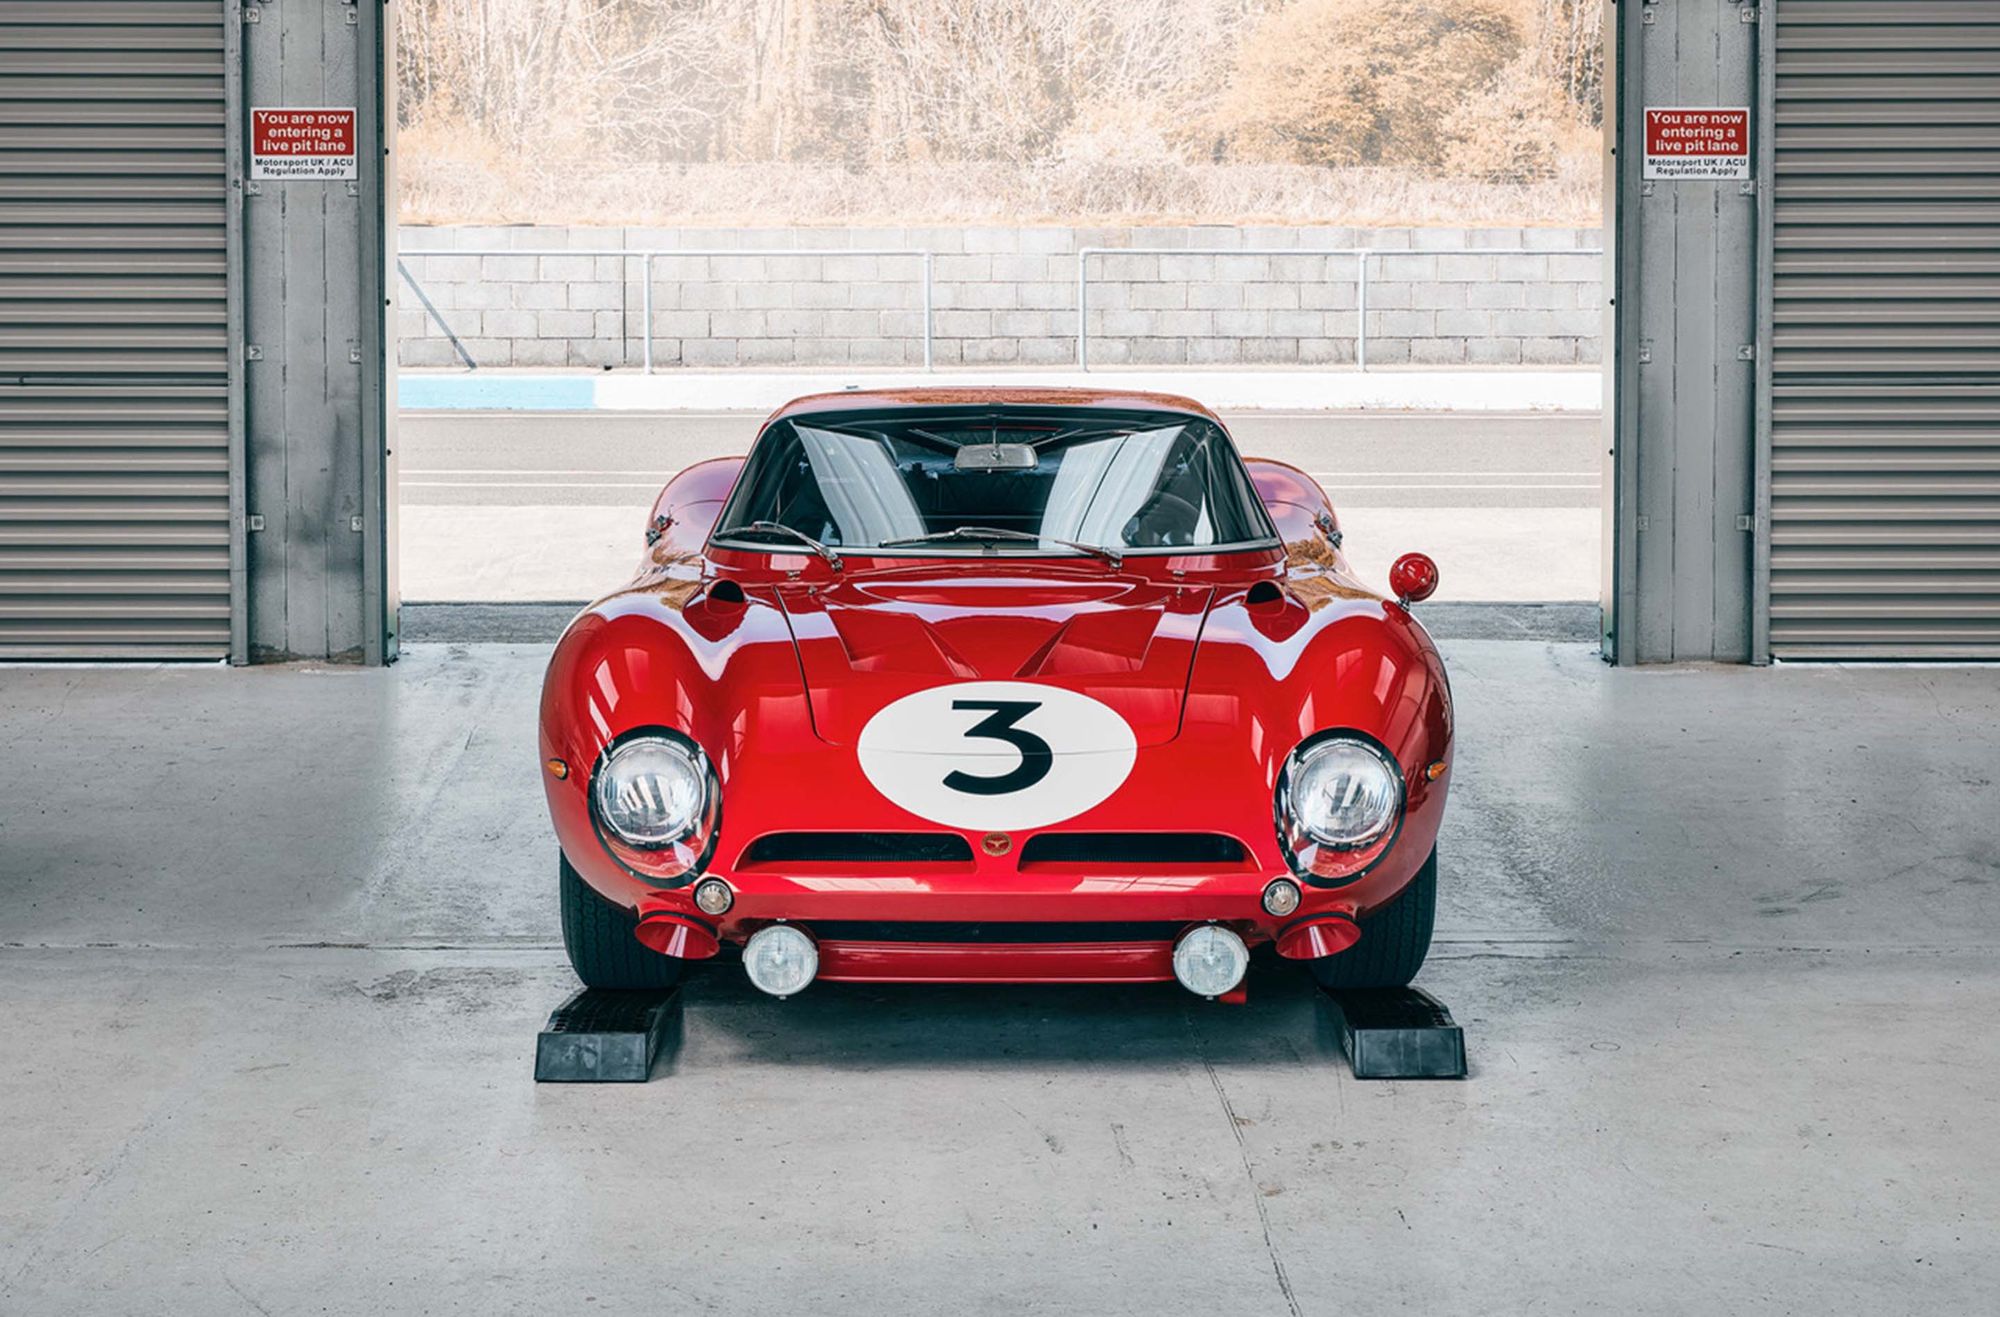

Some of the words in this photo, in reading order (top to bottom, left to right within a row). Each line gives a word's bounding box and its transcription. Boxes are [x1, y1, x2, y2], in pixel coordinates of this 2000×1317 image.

[258, 112, 287, 124] You
[291, 115, 315, 124] are
[318, 115, 350, 124] now
[1651, 112, 1680, 124] You
[1684, 115, 1708, 124] are
[1711, 115, 1742, 124] now
[268, 126, 331, 140] entering
[334, 128, 343, 137] a
[1661, 126, 1724, 140] entering
[1727, 128, 1736, 137] a
[262, 140, 289, 151] live
[292, 140, 312, 153] pit
[315, 140, 346, 151] lane
[1656, 140, 1682, 151] live
[1685, 140, 1704, 153] pit
[1708, 140, 1740, 151] lane
[255, 158, 309, 168] Motorsport
[311, 158, 325, 166] UK
[332, 158, 354, 166] ACU
[1648, 158, 1702, 168] Motorsport
[1704, 158, 1718, 166] UK
[1725, 158, 1747, 166] ACU
[263, 167, 315, 176] Regulation
[318, 167, 346, 176] Apply
[1656, 167, 1708, 176] Regulation
[1710, 167, 1738, 176] Apply
[942, 699, 1054, 796] 3
